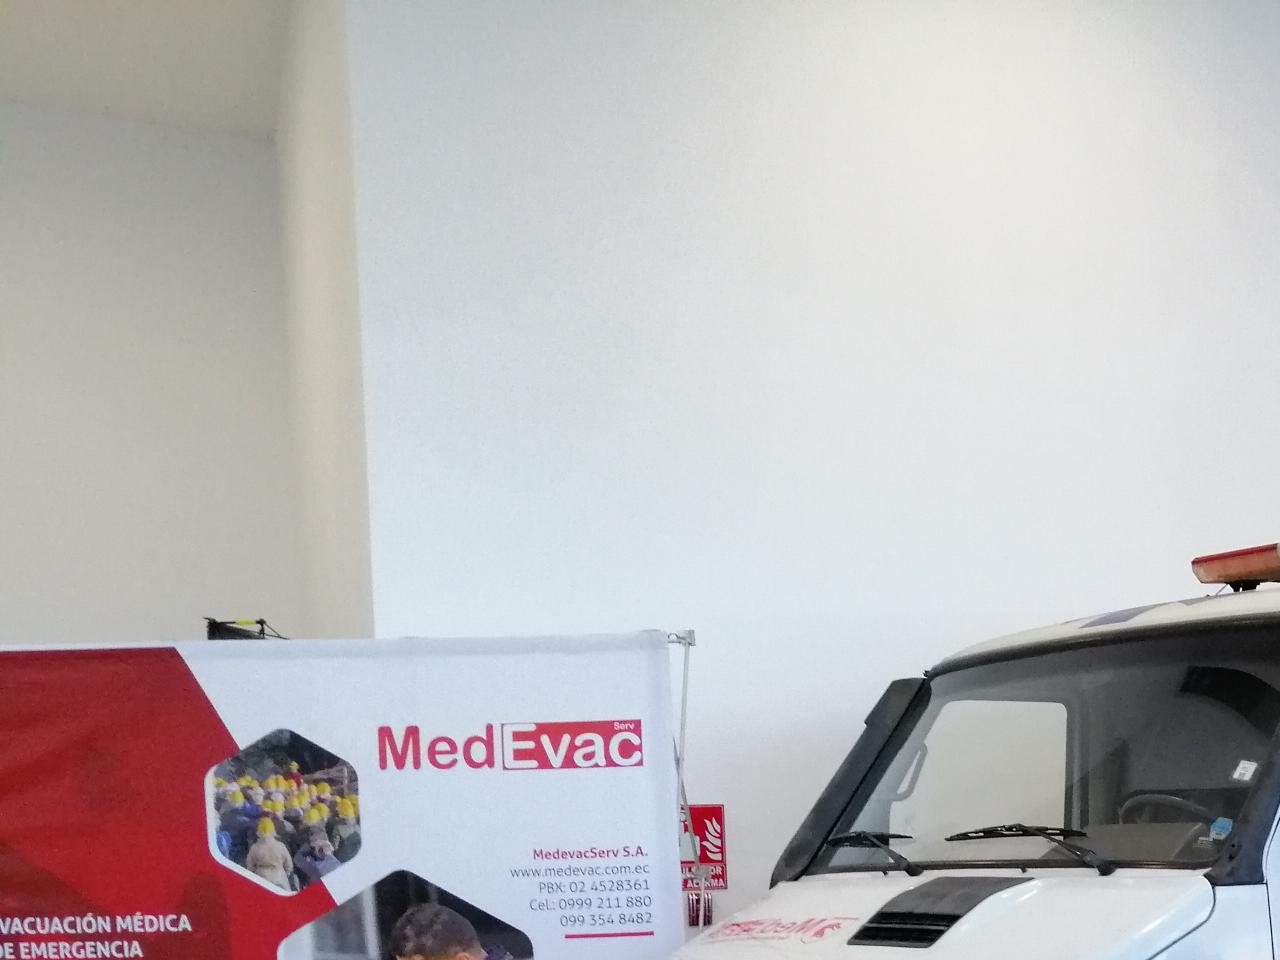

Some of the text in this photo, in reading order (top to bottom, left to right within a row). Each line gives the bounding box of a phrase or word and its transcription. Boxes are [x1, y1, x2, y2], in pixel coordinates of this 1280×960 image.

[613, 721, 635, 731] Serv
[378, 723, 642, 770] MedEvac
[533, 845, 648, 861] MedevacServ S.A.
[510, 864, 650, 878] www.medevac.com.ec
[538, 879, 650, 894] PBX: 02 4528361
[559, 897, 592, 910] 0999
[597, 897, 621, 909] 211
[626, 895, 652, 908] 880
[116, 911, 192, 933] MÉDICA
[560, 912, 652, 927] 099 354 8482
[19, 940, 144, 959] EMERGENCIA
